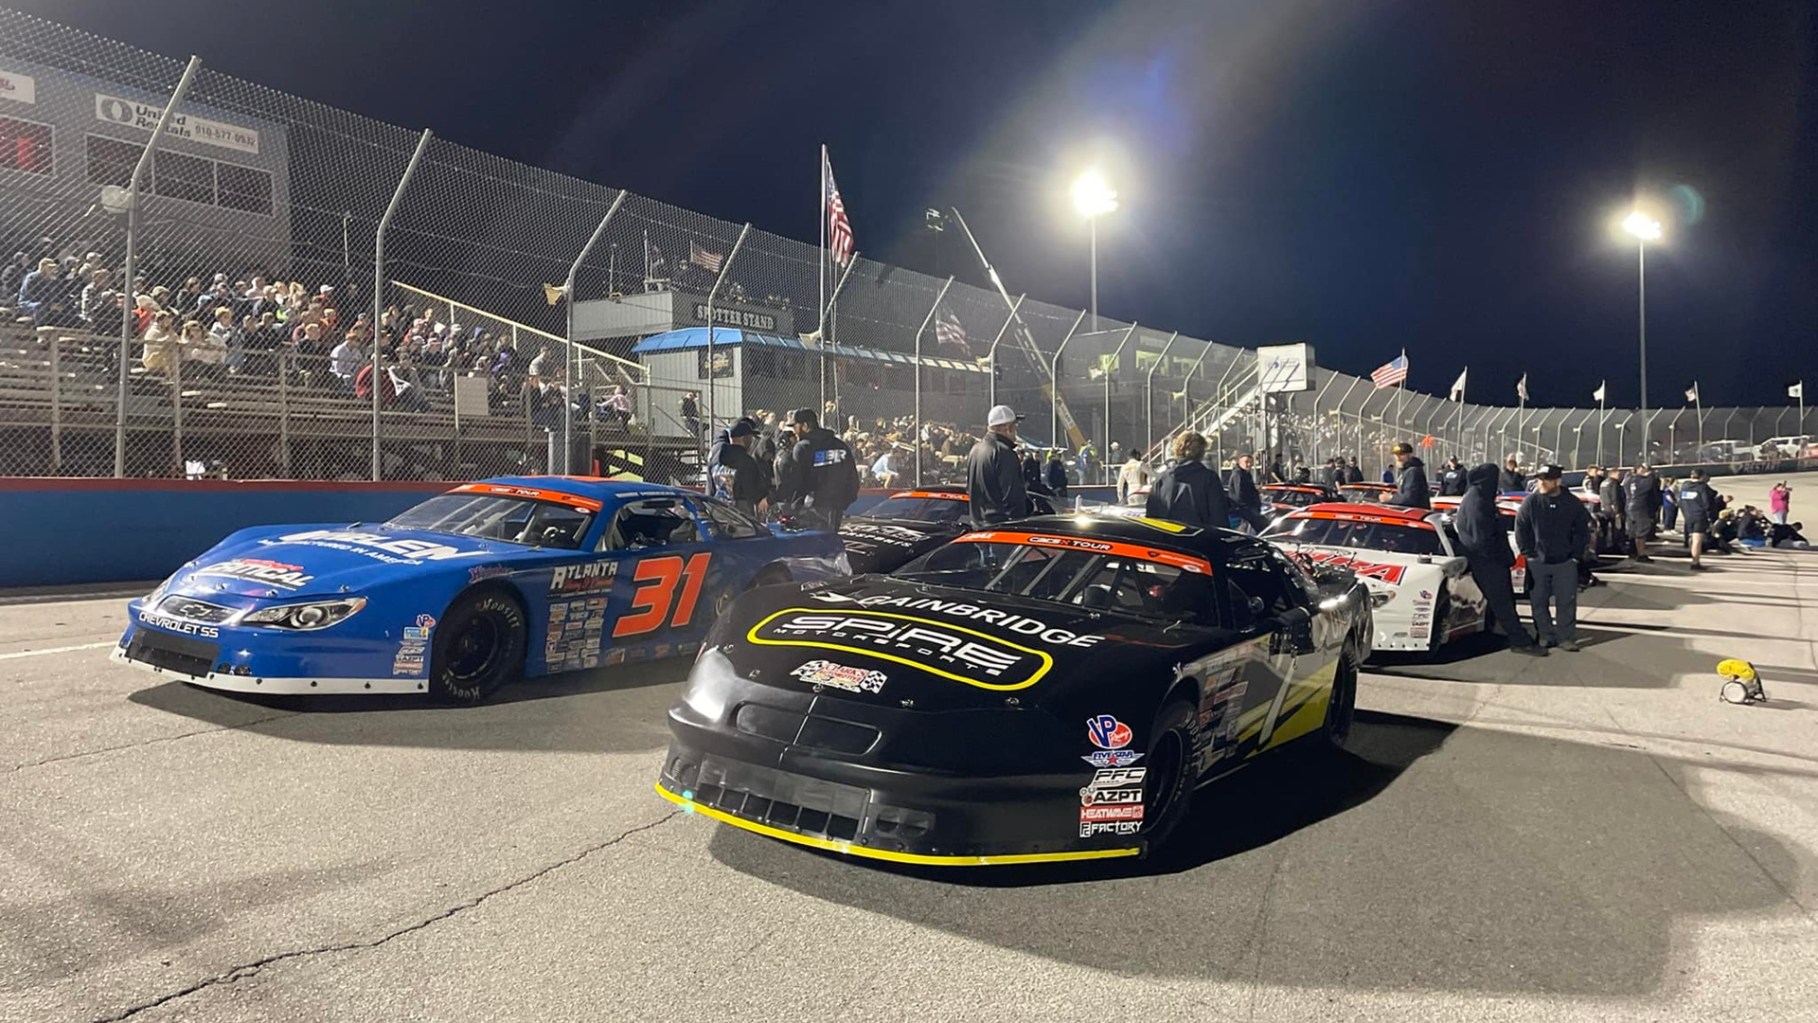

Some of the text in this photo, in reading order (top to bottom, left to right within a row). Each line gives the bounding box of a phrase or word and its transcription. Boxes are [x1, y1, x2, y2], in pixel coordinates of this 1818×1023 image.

[136, 105, 187, 126] Unid
[743, 312, 774, 330] STAND
[1072, 539, 1112, 551] TOUR
[550, 561, 619, 589] ATLANTA
[612, 552, 712, 638] 31
[139, 611, 219, 638] CHEVROLET SS
[859, 594, 1106, 648] GAINBRIDGE
[783, 616, 1022, 670] SPIRE
[1086, 714, 1117, 748] VP
[1095, 768, 1146, 781] PFC
[1093, 790, 1141, 802] AZPT
[1081, 807, 1132, 819] HEATWAVE
[1092, 820, 1143, 835] FACTORY
